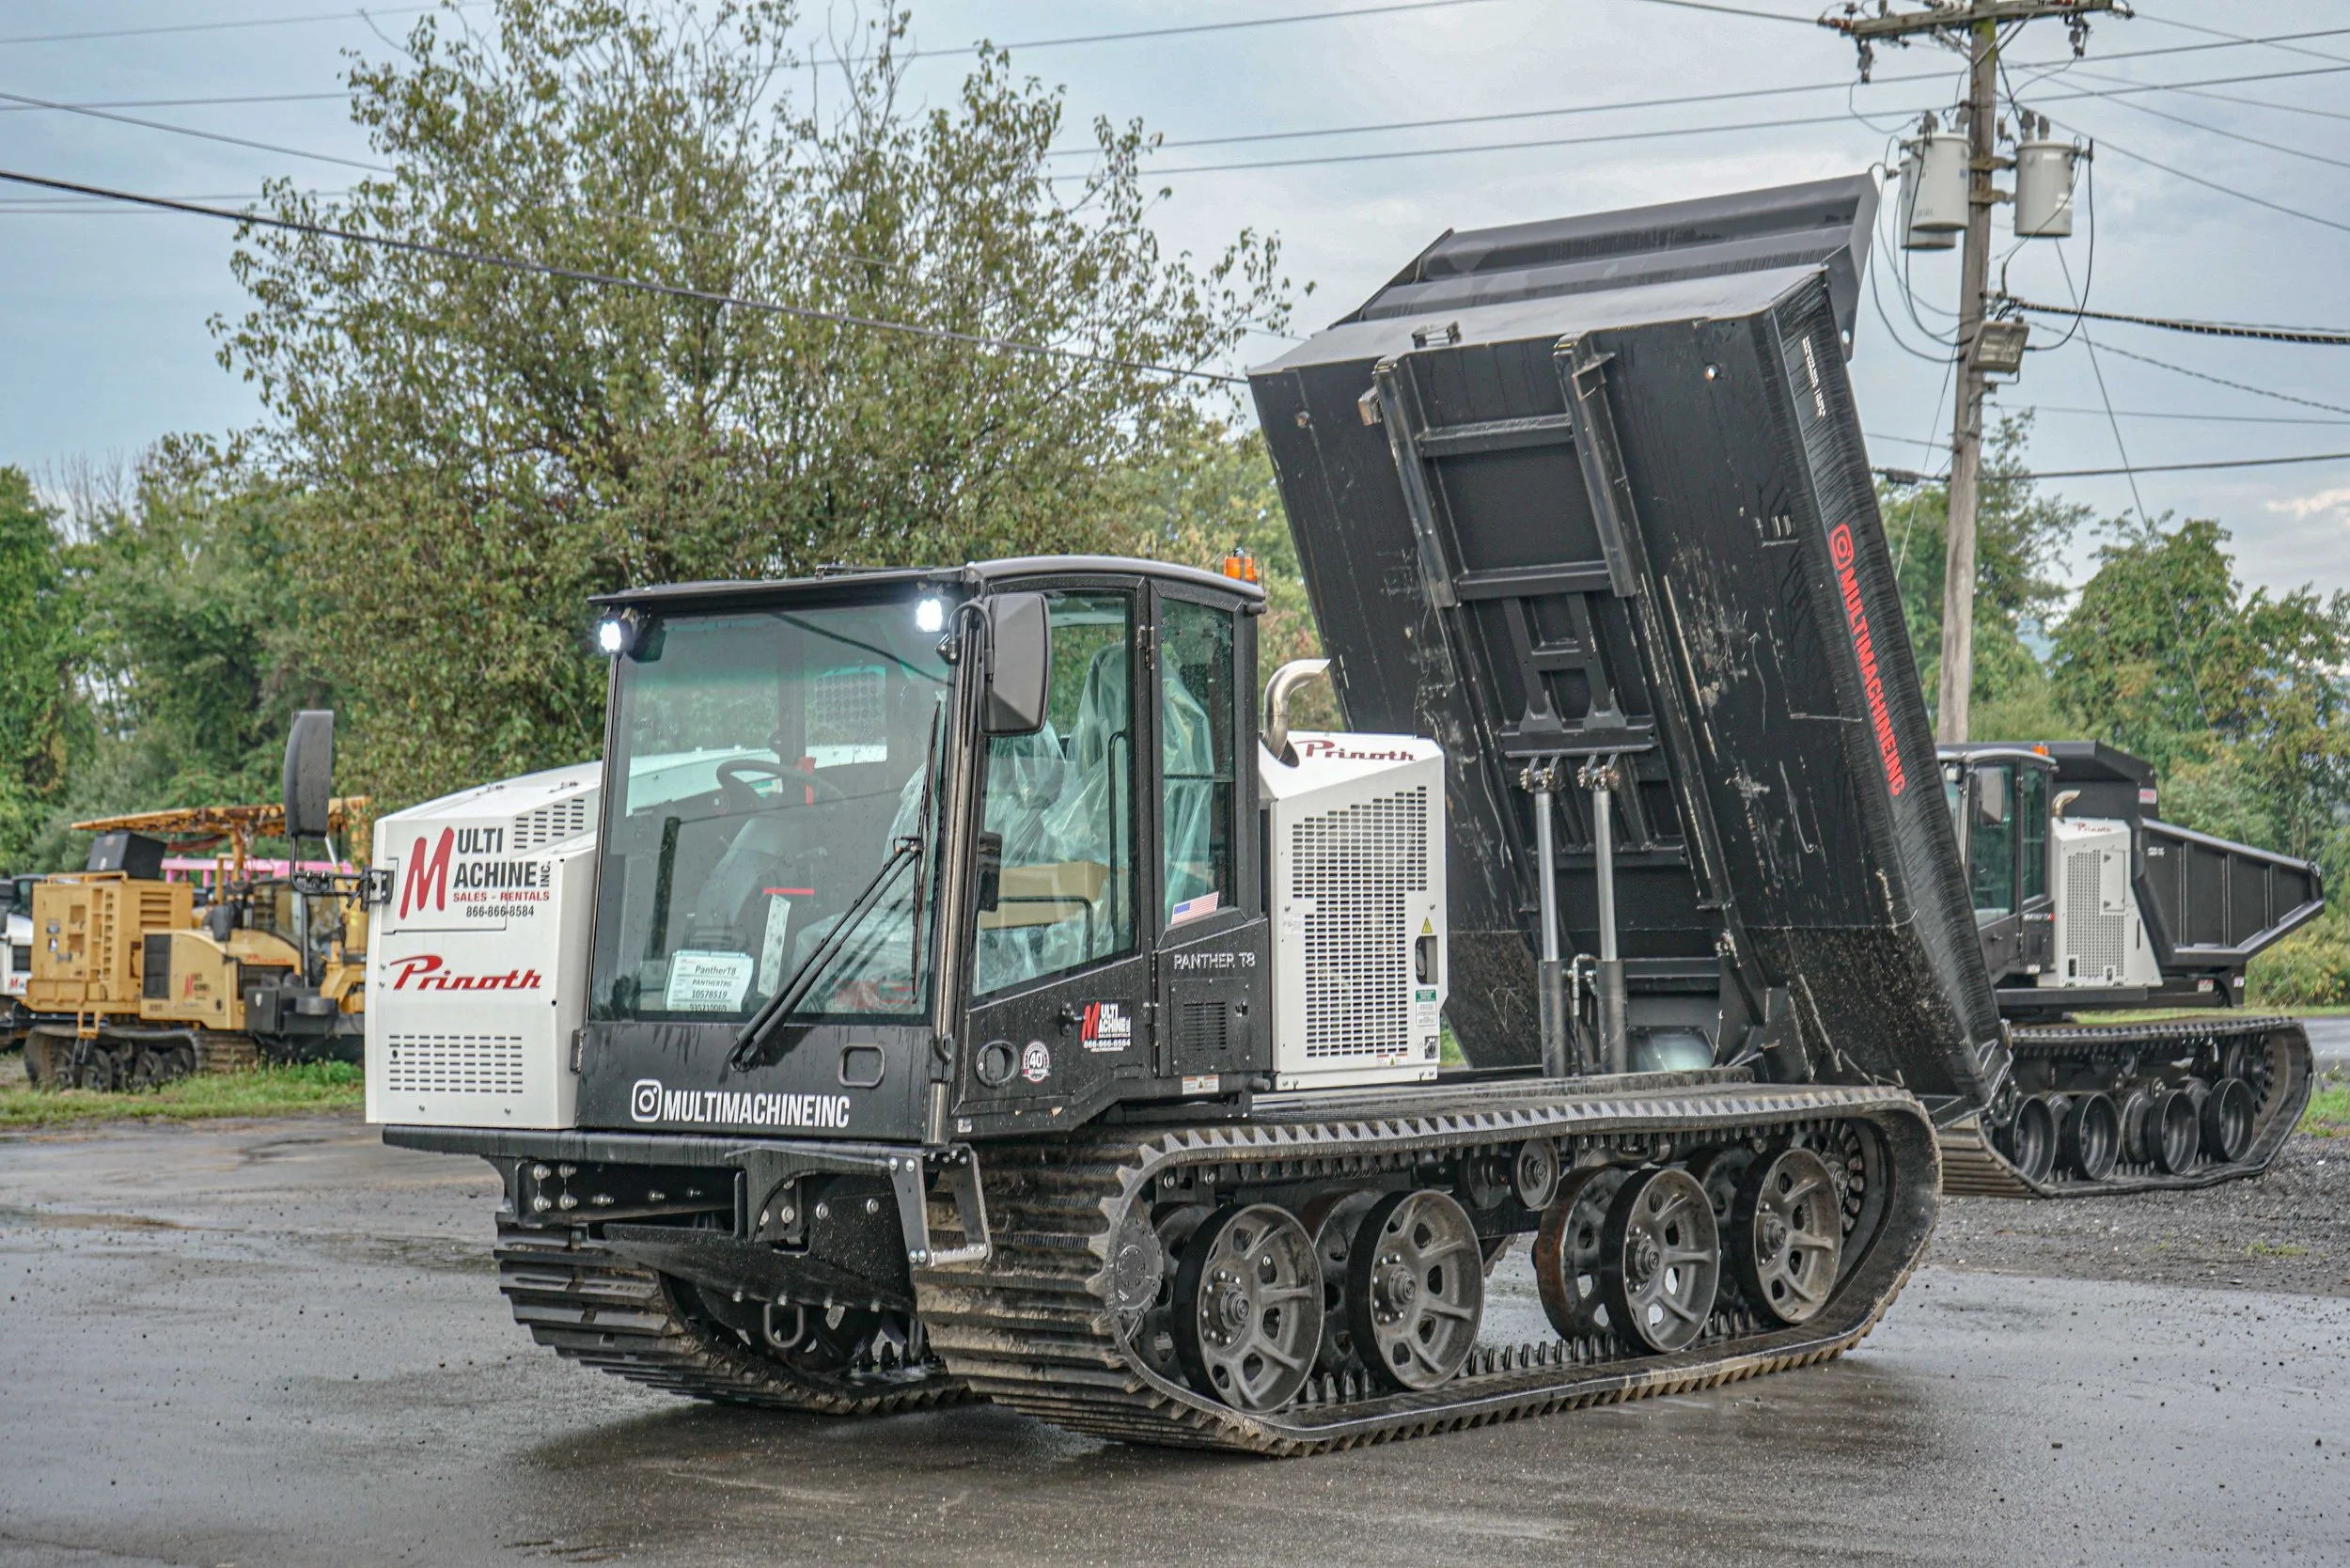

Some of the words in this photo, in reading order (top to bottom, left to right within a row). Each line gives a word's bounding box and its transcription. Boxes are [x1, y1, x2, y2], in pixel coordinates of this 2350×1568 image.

[1839, 566, 1906, 797] MULTIMACHINEINC
[1294, 740, 1417, 761] Prinoth
[539, 860, 552, 887] INC.
[453, 891, 488, 902] SALES
[500, 889, 550, 902] RENTALS
[465, 903, 535, 917] 866-866-8584
[1173, 952, 1235, 970] PANTHER
[1238, 951, 1256, 968] T8
[389, 954, 542, 991] Prinoth
[1029, 1051, 1043, 1068] 40
[662, 1090, 851, 1129] MULTIMACHINEINC
